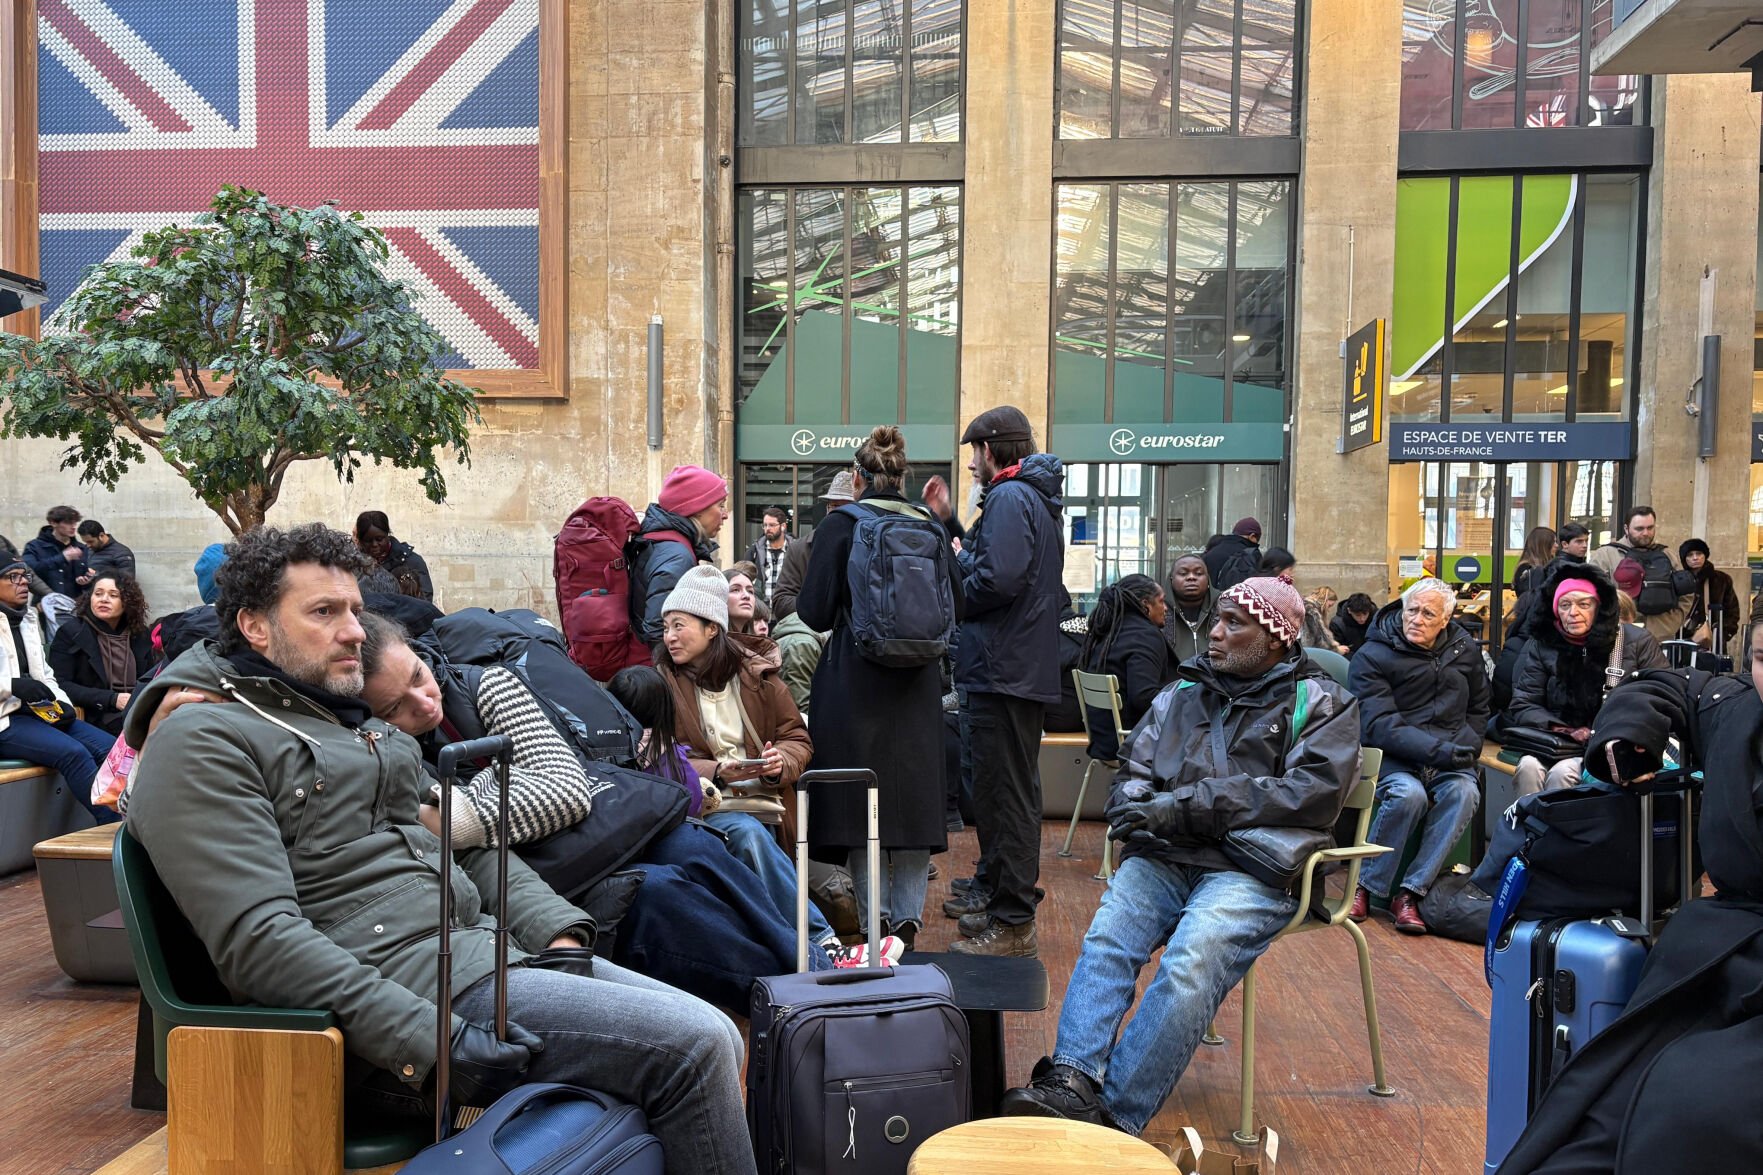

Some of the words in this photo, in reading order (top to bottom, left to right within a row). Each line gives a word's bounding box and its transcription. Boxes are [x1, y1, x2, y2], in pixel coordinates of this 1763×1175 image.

[1140, 433, 1225, 448] eurostar
[1403, 431, 1458, 443] ESPACE
[1461, 431, 1482, 443] DE
[1485, 431, 1534, 443] VENTE
[1538, 431, 1567, 443] TER
[1402, 446, 1493, 456] HAUTS-DE-FRANCE
